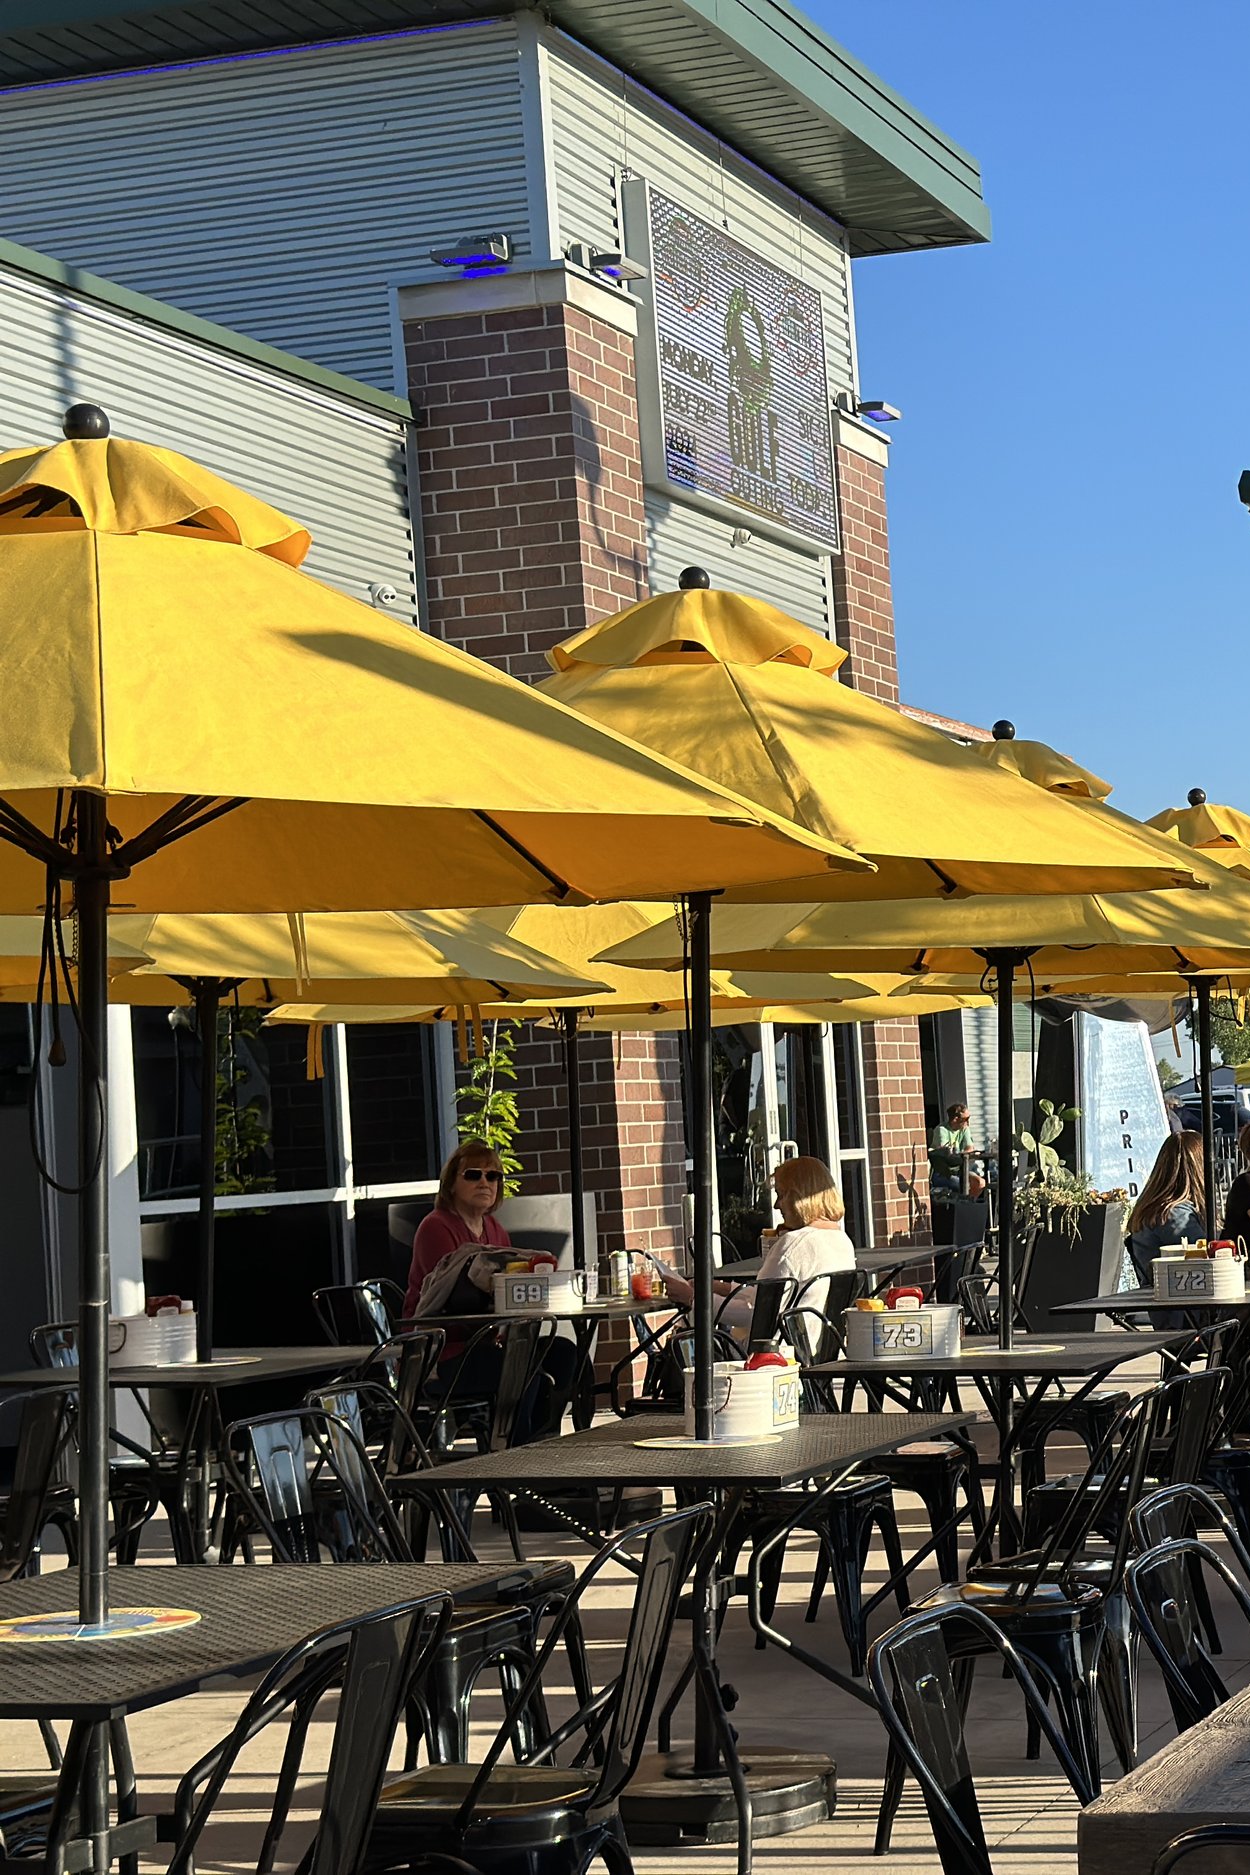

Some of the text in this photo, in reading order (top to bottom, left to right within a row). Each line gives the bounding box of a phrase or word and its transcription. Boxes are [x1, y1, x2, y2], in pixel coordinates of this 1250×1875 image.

[1119, 1109, 1139, 1198] PRID
[512, 1283, 543, 1304] 69
[1175, 1270, 1206, 1291] 72
[883, 1322, 922, 1348] 73
[779, 1382, 797, 1416] 74
